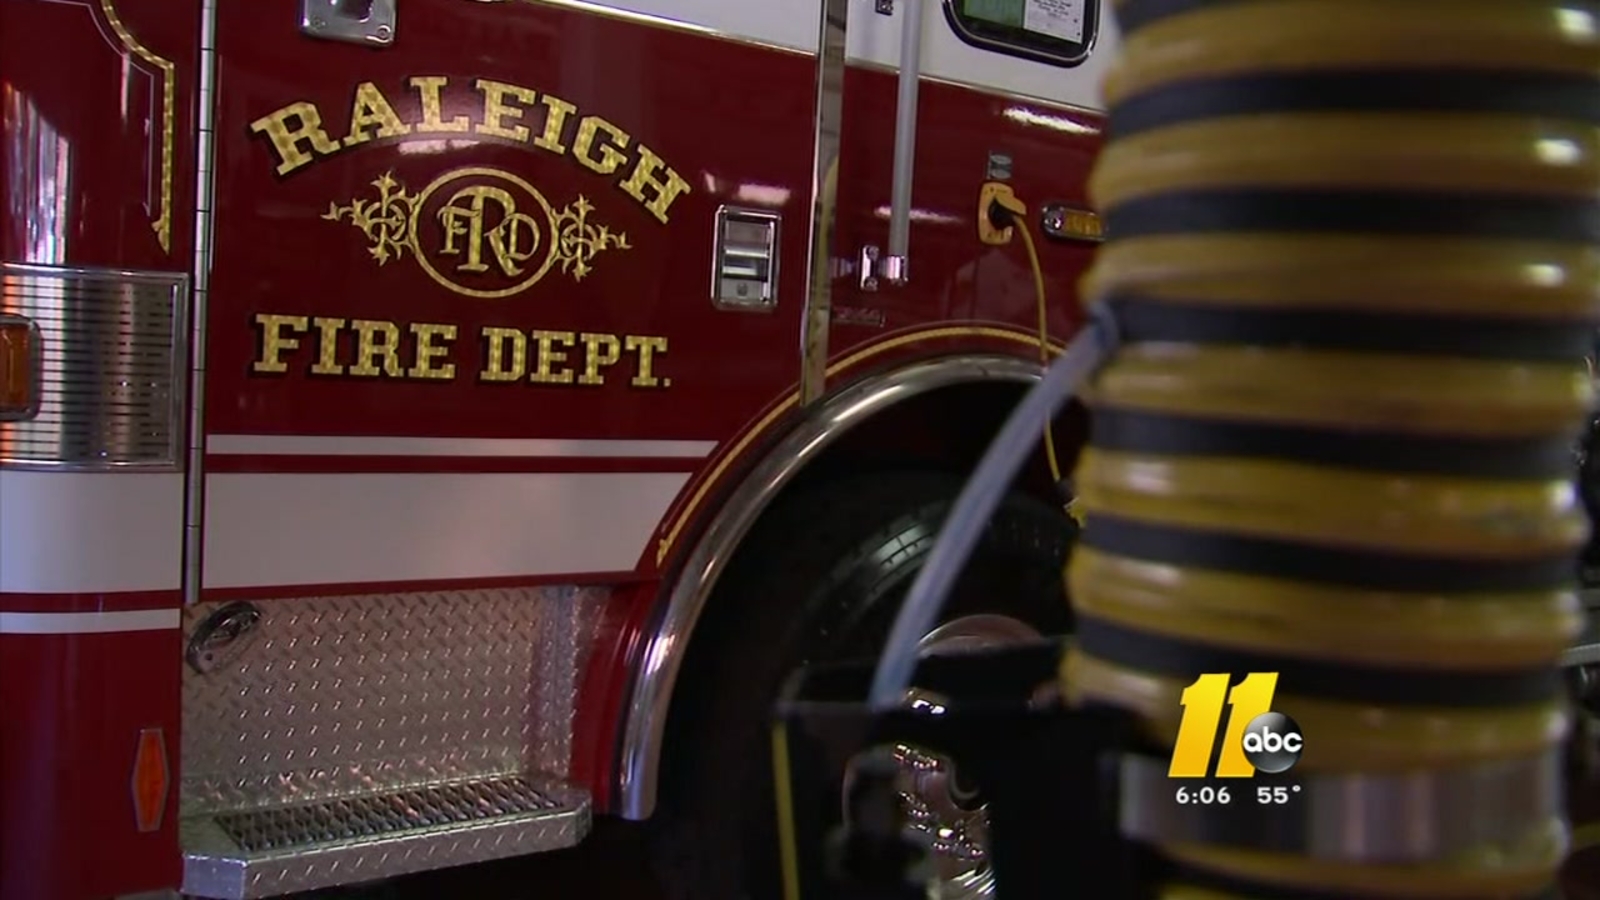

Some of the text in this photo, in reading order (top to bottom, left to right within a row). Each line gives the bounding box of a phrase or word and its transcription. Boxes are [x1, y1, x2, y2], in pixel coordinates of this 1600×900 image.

[250, 76, 691, 224] RALEIGH
[254, 314, 671, 387] FIRE DEPT.
